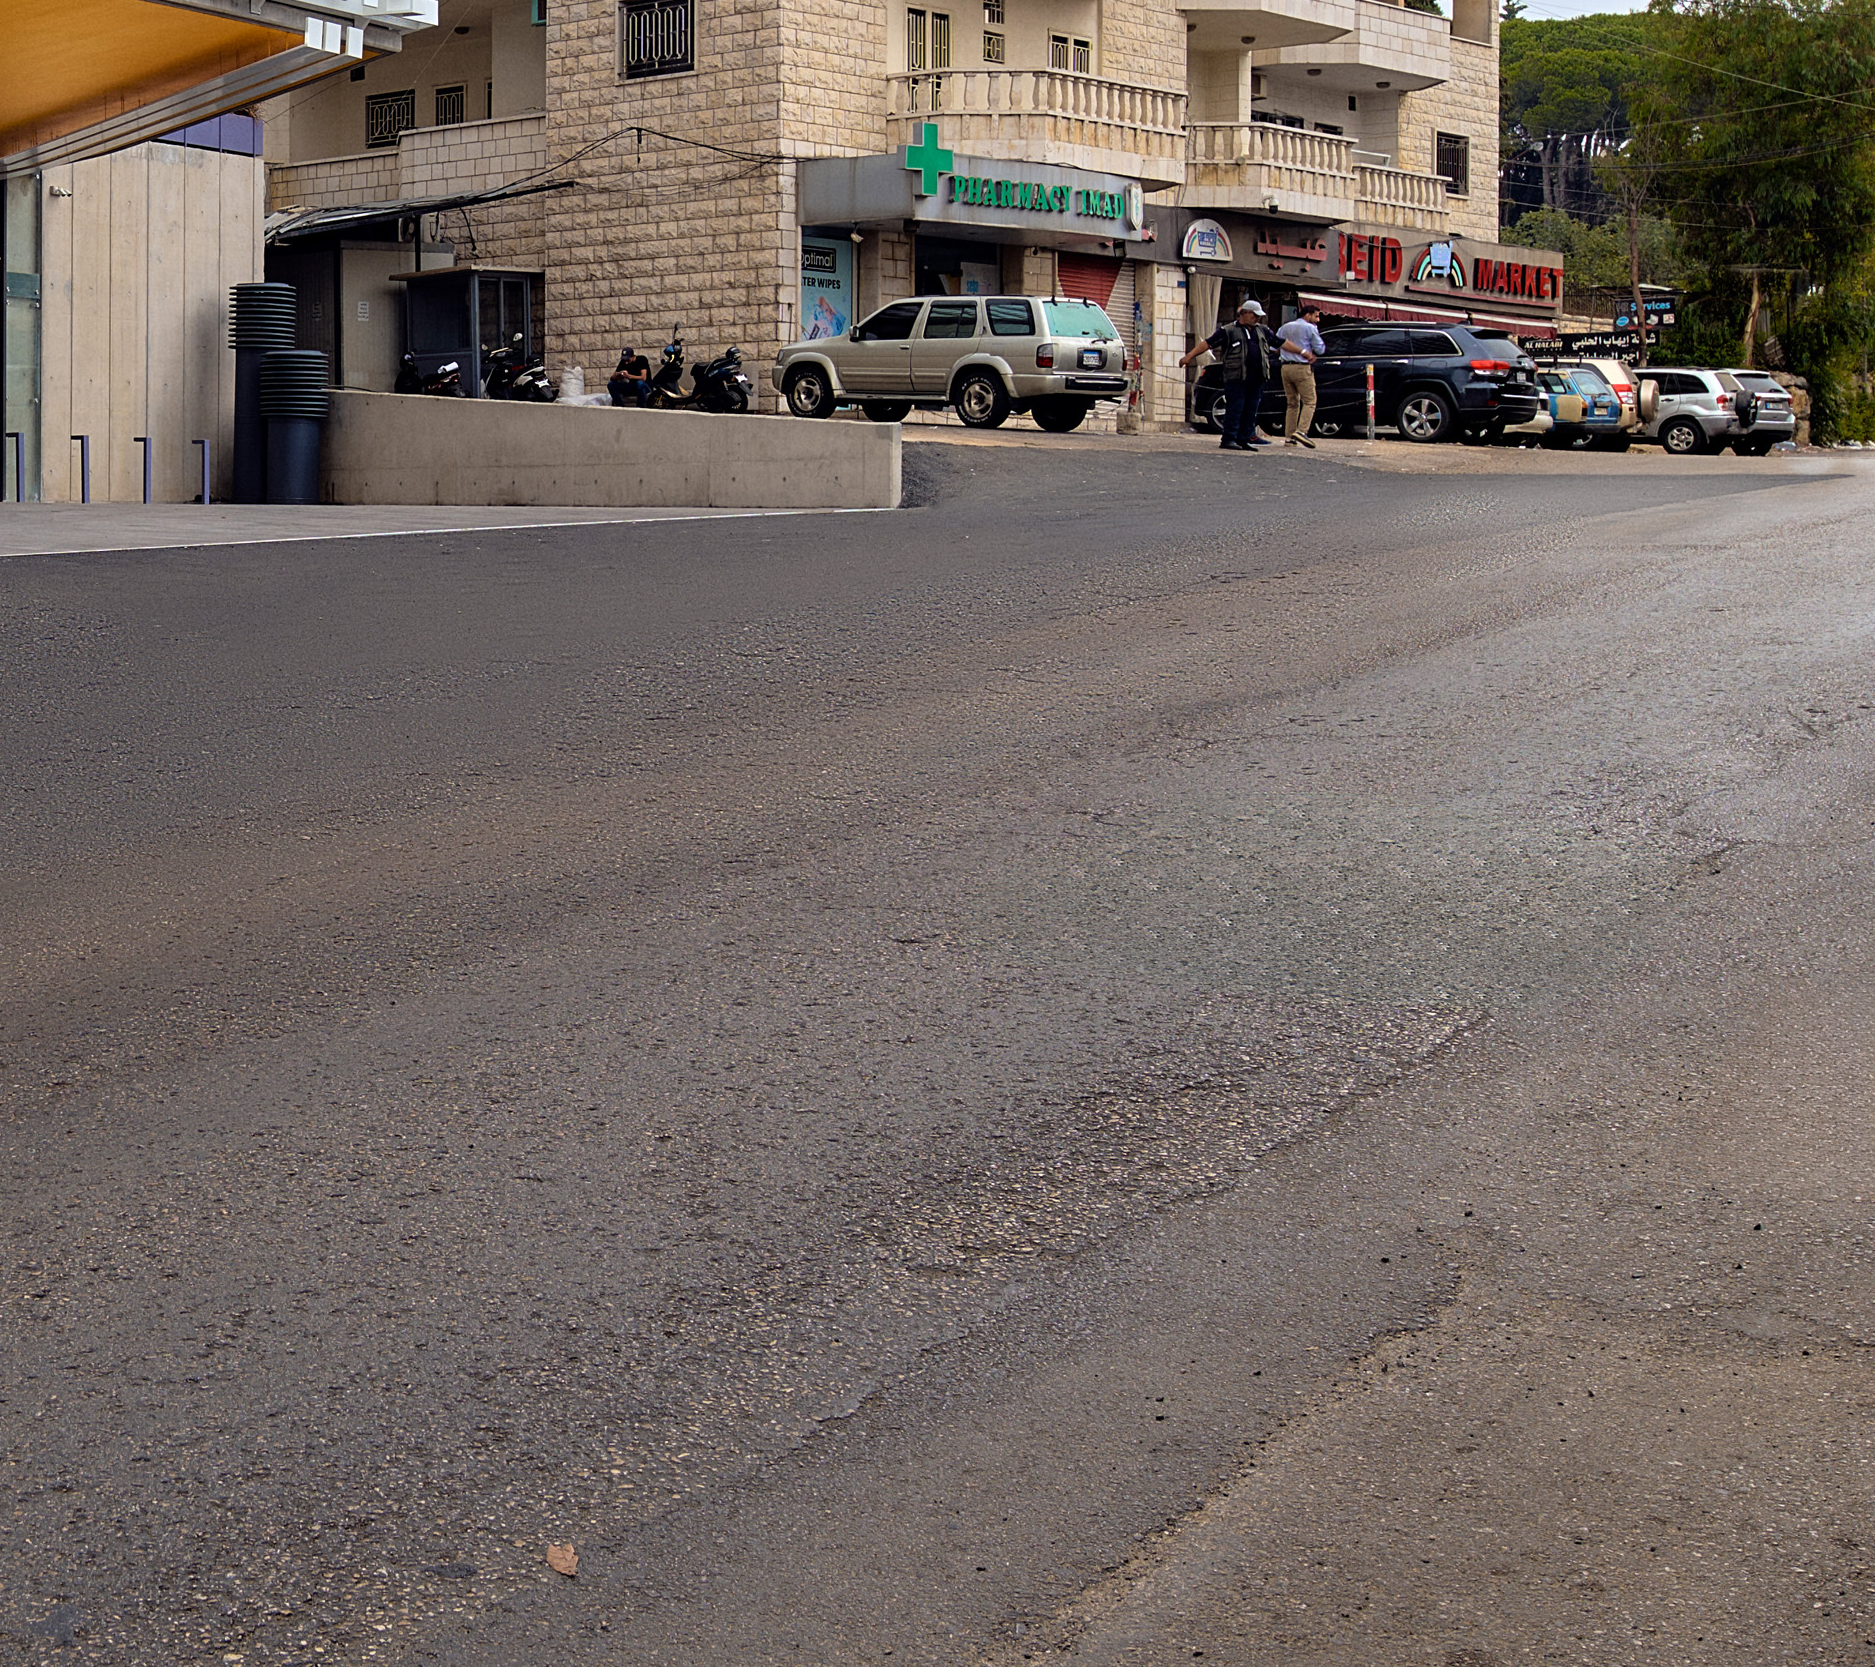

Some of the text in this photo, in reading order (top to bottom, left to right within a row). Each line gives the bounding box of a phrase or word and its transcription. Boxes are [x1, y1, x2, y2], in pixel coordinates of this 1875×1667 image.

[951, 175, 1073, 212] PHARMACY
[1079, 189, 1124, 219] IMAD
[801, 276, 841, 290] TER WIPES
[1474, 257, 1565, 300] MARKET
[1631, 300, 1671, 311] Srvices
[1630, 332, 1656, 344] شرة
